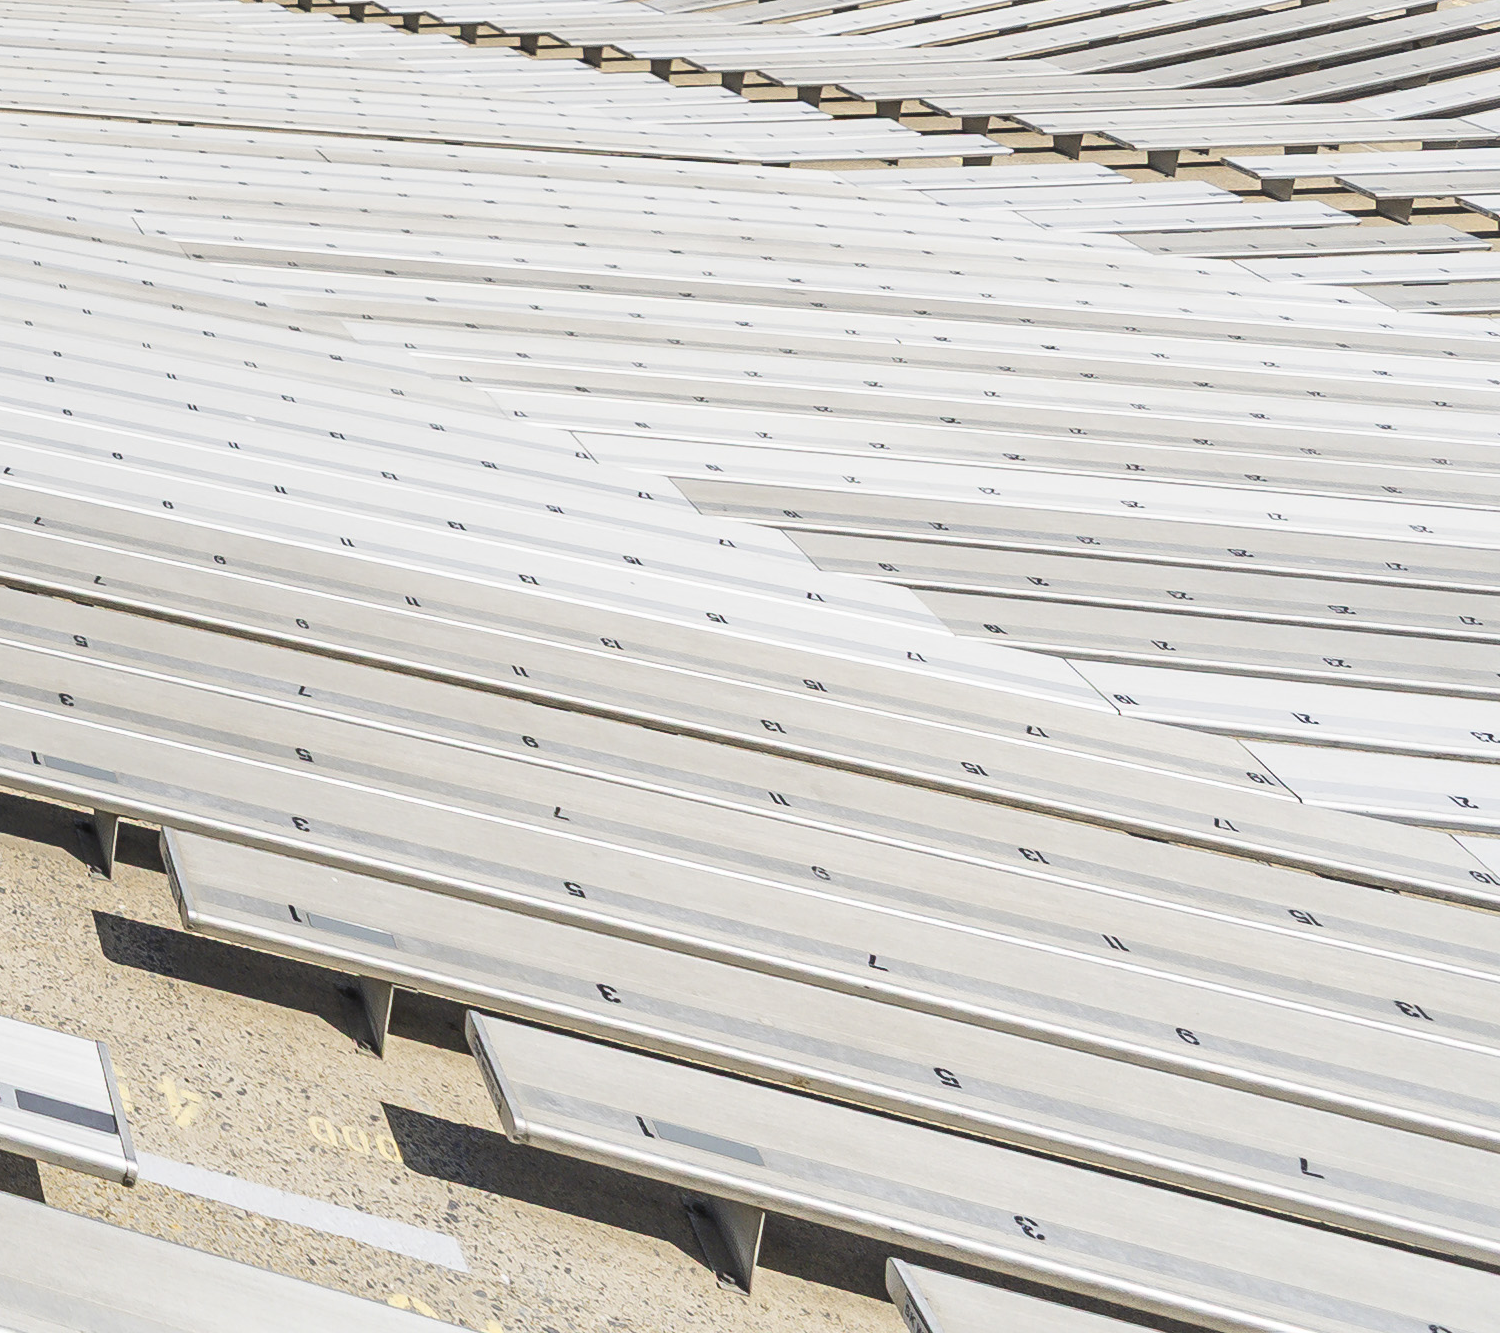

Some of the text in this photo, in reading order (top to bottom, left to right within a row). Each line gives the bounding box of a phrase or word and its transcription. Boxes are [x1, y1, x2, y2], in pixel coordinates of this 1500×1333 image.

[595, 983, 622, 1004] 3
[1393, 1000, 1434, 1022] 13
[933, 1067, 962, 1089] 5
[1299, 1157, 1325, 1180] 7
[1013, 1215, 1046, 1241] 3
